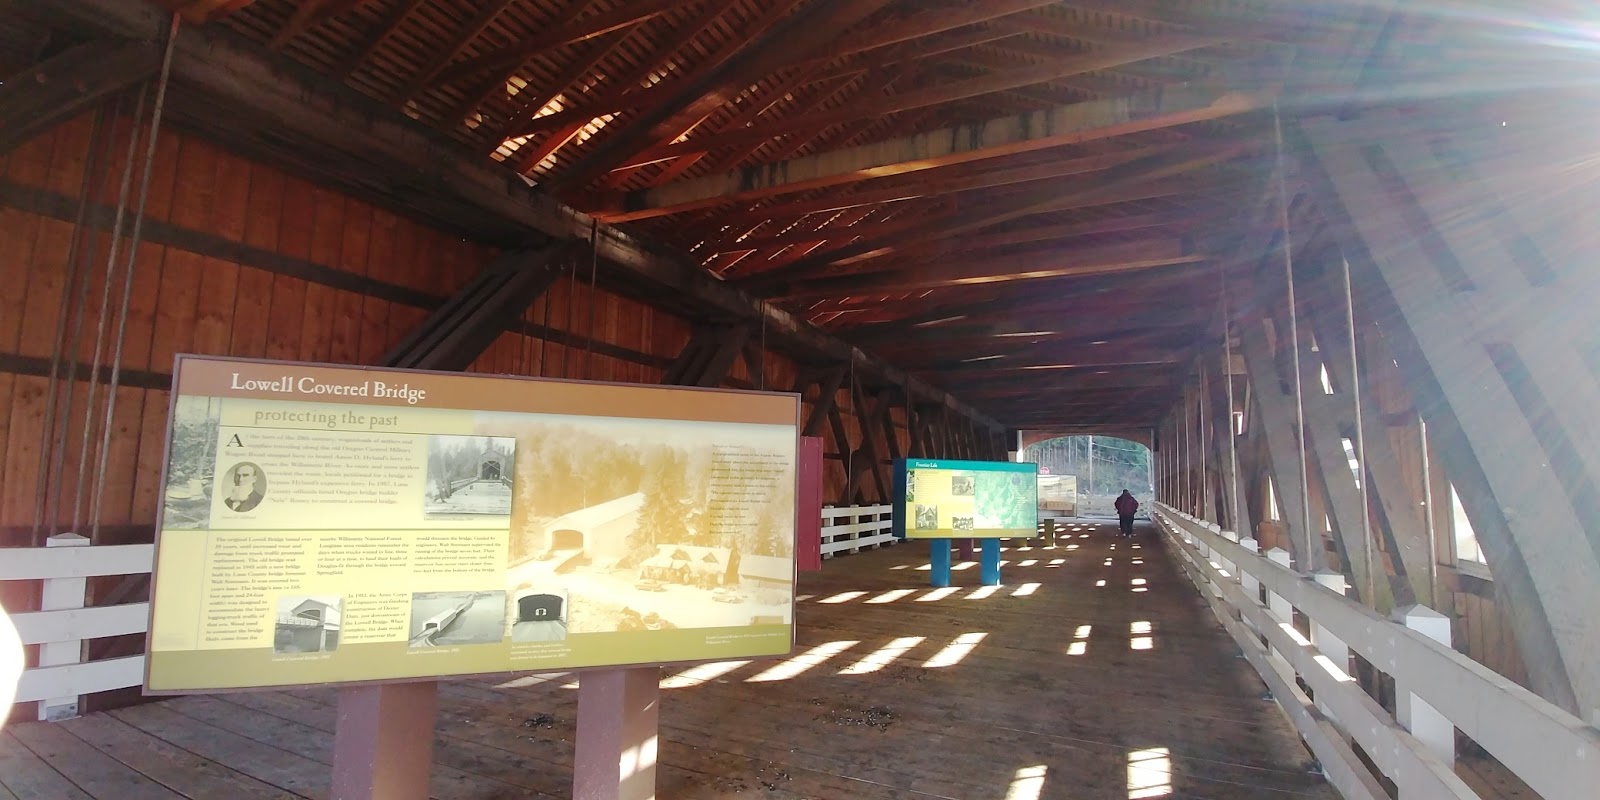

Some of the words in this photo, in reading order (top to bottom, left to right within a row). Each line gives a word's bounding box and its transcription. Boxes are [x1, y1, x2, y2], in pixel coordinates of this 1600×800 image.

[230, 373, 292, 392] Lowell
[298, 377, 368, 397] Covered
[374, 382, 426, 404] Bridge
[254, 409, 336, 428] protecting
[342, 410, 364, 424] the
[370, 414, 398, 430] past
